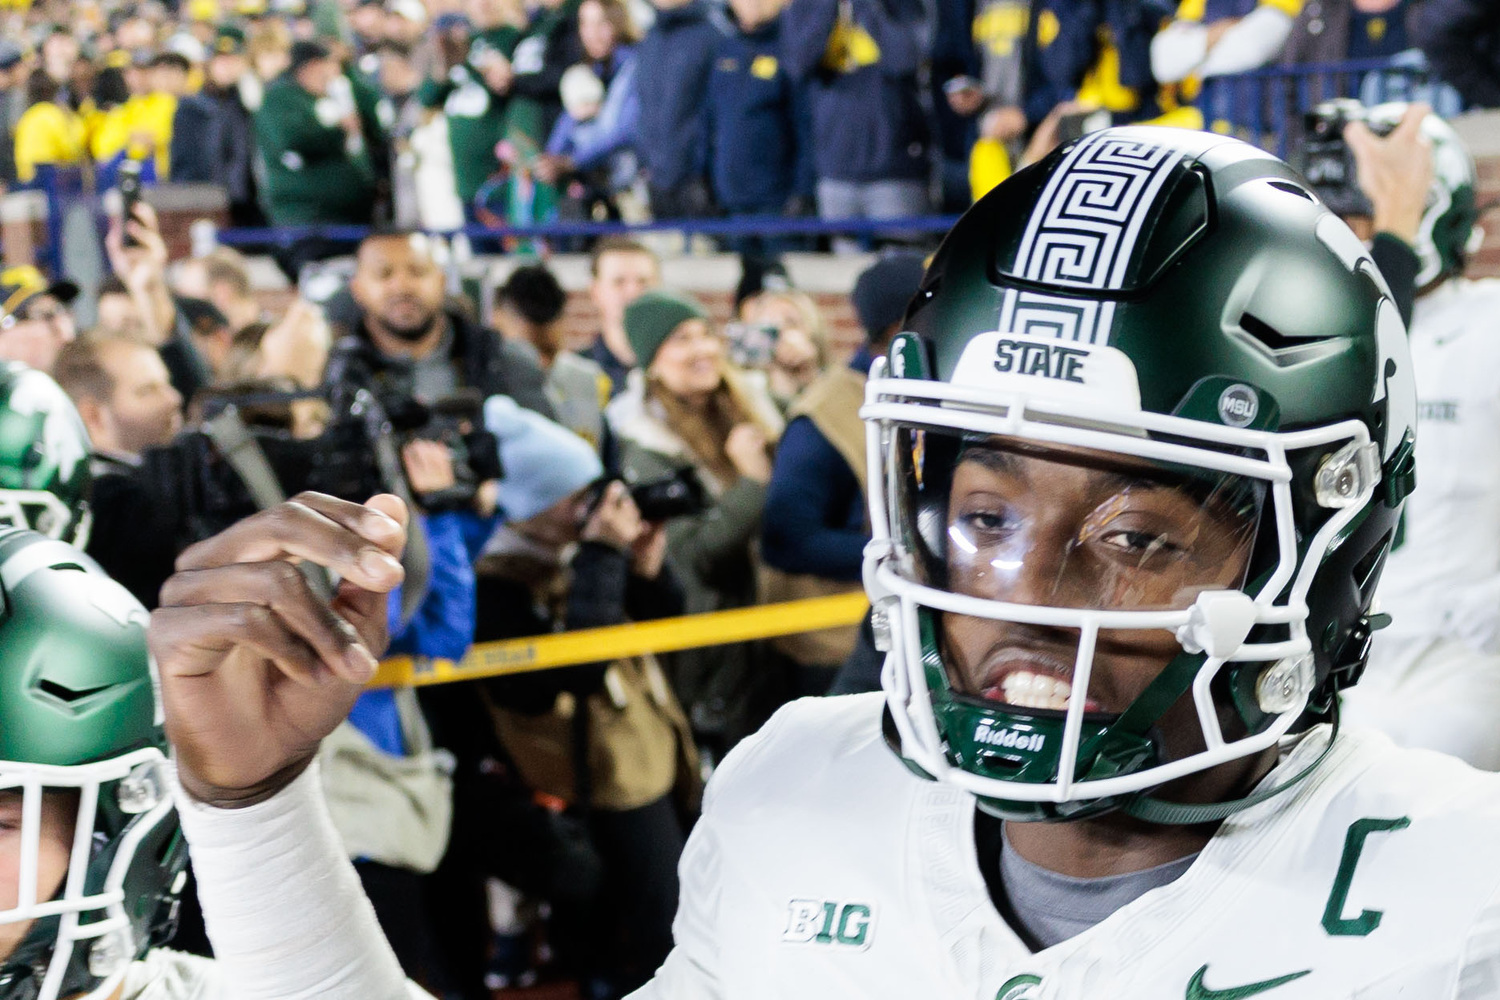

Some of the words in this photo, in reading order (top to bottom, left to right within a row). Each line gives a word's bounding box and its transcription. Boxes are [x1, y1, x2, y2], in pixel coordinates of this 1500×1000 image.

[993, 339, 1090, 384] STATE
[1222, 397, 1255, 418] MSU
[974, 724, 1046, 753] Riddell
[1321, 815, 1411, 936] C
